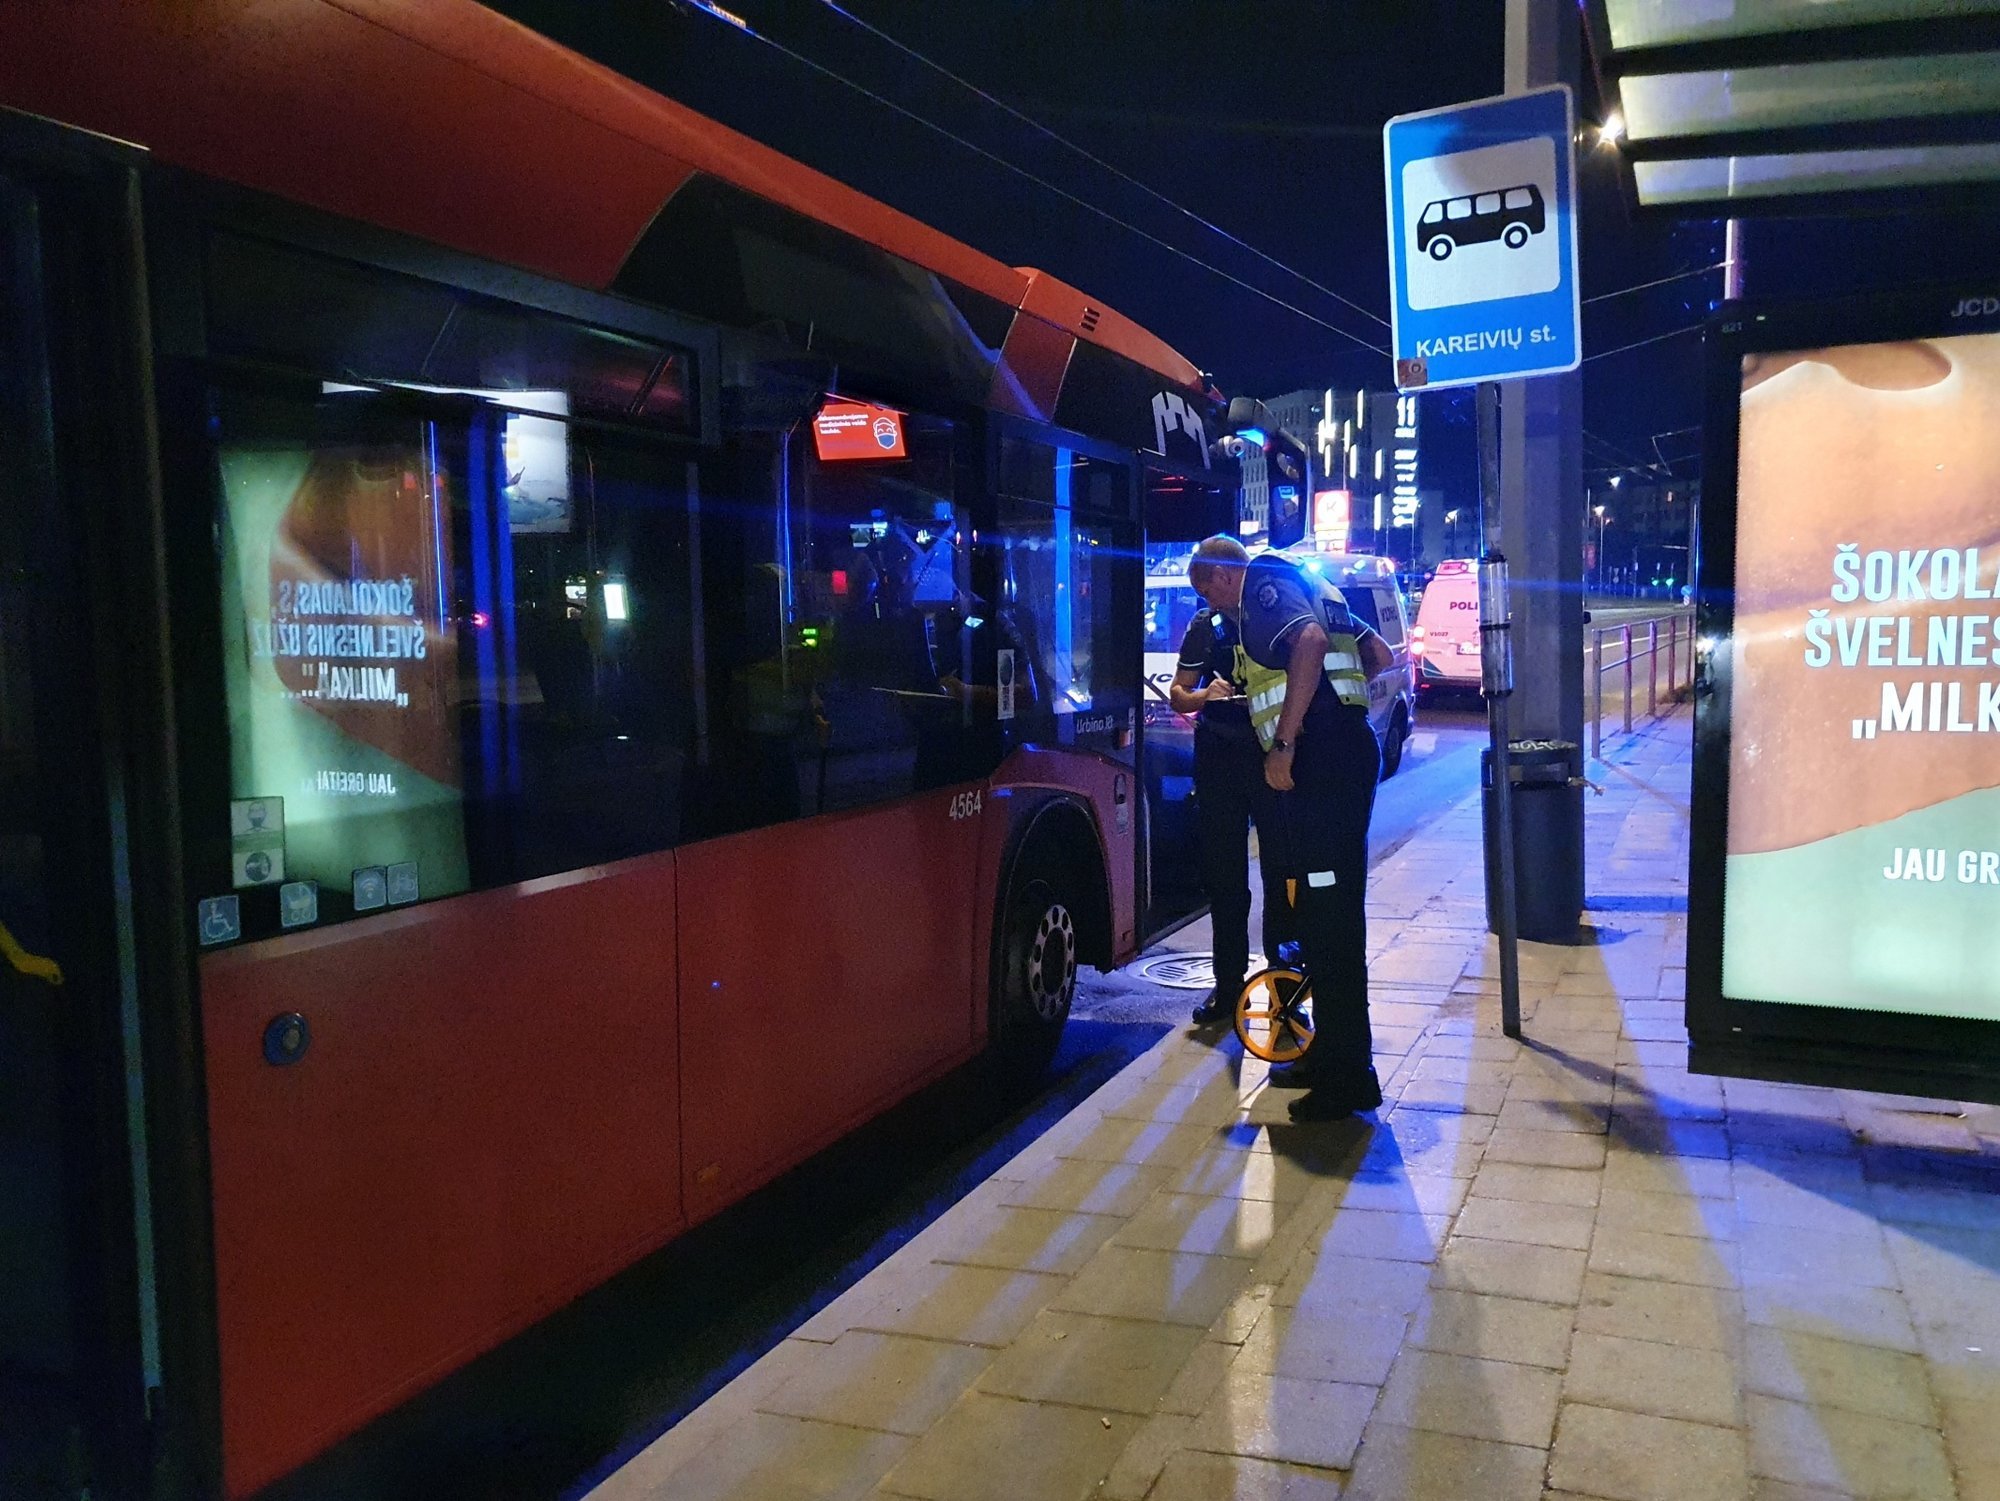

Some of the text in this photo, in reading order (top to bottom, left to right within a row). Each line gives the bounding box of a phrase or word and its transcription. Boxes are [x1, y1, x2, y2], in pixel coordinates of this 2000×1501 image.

[1416, 324, 1557, 357] KAREIVIŲ st.
[1076, 717, 1104, 735] Urbino
[949, 789, 982, 821] 4564
[1883, 848, 2000, 885] JAU GR
